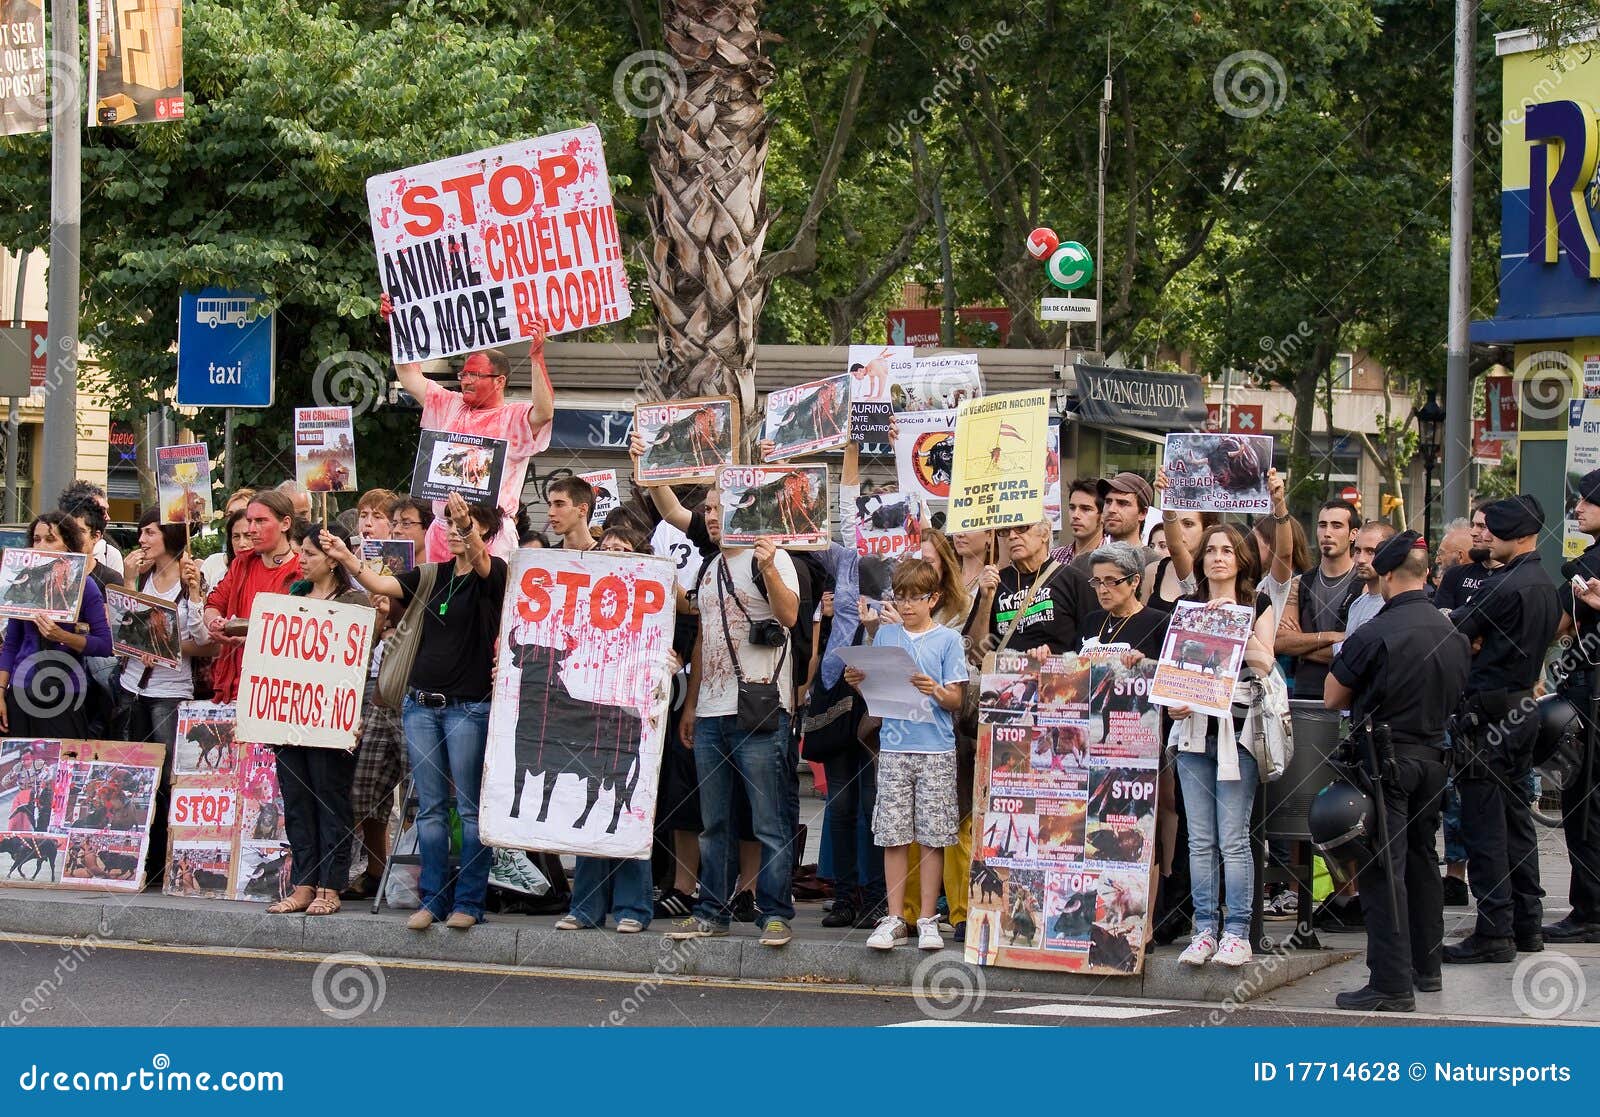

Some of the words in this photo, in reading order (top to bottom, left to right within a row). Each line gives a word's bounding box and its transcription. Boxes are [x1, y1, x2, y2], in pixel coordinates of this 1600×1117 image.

[12, 22, 36, 45] SER
[6, 49, 28, 74] QUE
[401, 155, 579, 237] STOP
[384, 232, 481, 306] ANIMAL
[484, 205, 619, 282] CRUELTY!!
[391, 305, 431, 361] NO
[433, 286, 511, 354] MORE
[512, 266, 619, 337] BLOOD!!
[208, 361, 242, 384] taxi
[891, 362, 912, 370] ELLOS
[770, 388, 804, 410] STOP
[970, 400, 1007, 416] VERGÜENZA
[1008, 396, 1046, 410] NACIONAL
[300, 410, 311, 420] SIN
[640, 408, 678, 426] STOP
[1169, 461, 1186, 473] LA
[722, 468, 766, 488] STOP
[964, 480, 1028, 495] TORTURA
[954, 495, 972, 508] NO
[978, 493, 994, 506] ES
[999, 489, 1038, 502] ARTE
[1164, 496, 1200, 508] FUERZA
[1213, 492, 1228, 500] LOS
[1214, 500, 1268, 508] COBARDES
[986, 503, 1000, 514] NI
[962, 513, 1024, 528] CULTURA
[6, 551, 40, 568] STOP
[670, 544, 691, 569] 13
[108, 590, 138, 611] STOP
[517, 567, 666, 632] STOP
[260, 612, 338, 664] TOROS:
[344, 623, 368, 667] SI
[1000, 657, 1028, 672] STOP
[249, 676, 328, 728] TOREROS:
[330, 687, 356, 732] NO
[996, 728, 1026, 742] STOP
[1112, 781, 1154, 800] STOP
[175, 795, 231, 824] STOP
[993, 798, 1023, 814] STOP
[1050, 873, 1092, 892] STOP
